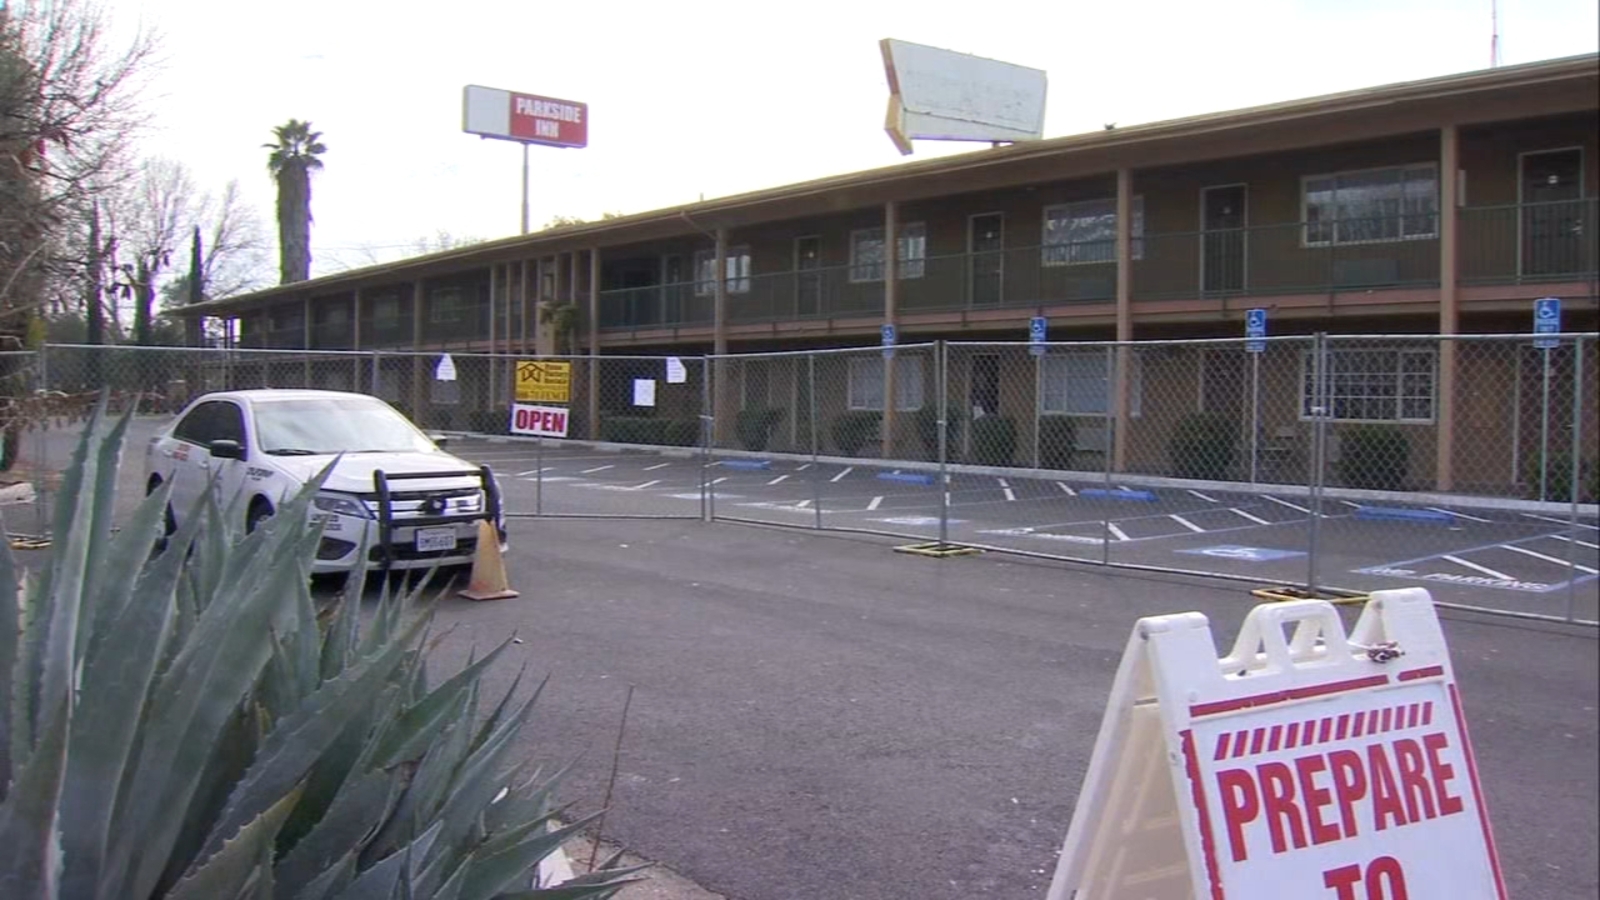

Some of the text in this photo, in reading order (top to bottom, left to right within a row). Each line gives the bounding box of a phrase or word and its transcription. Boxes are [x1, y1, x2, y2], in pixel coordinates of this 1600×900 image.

[515, 97, 581, 123] PARKSIDE
[535, 119, 559, 138] INN
[515, 409, 565, 433] OPEN
[1216, 731, 1464, 862] PREPARE
